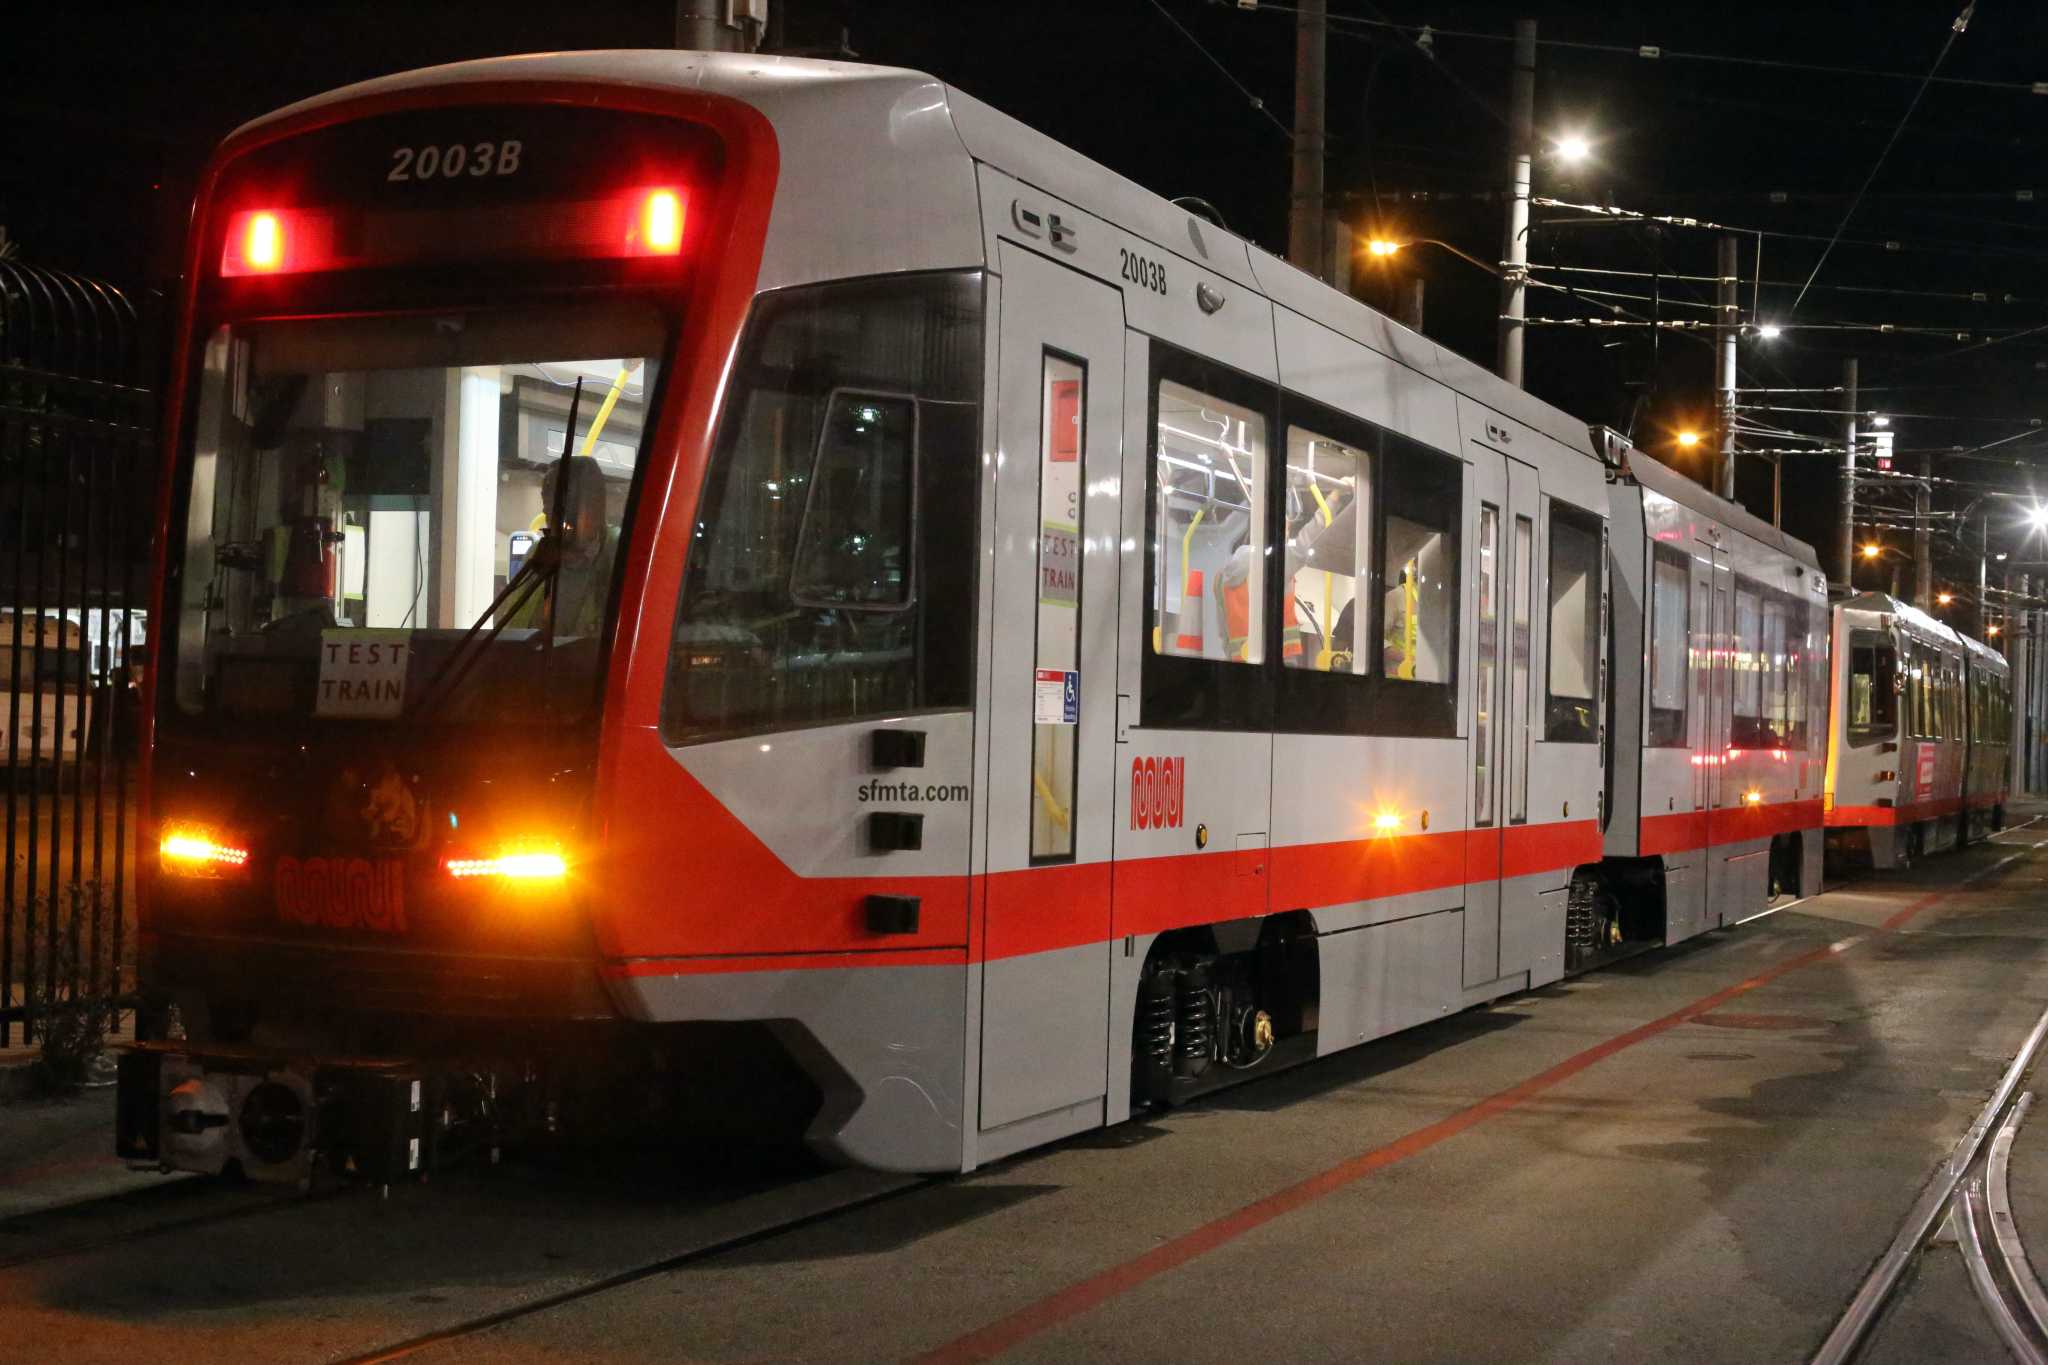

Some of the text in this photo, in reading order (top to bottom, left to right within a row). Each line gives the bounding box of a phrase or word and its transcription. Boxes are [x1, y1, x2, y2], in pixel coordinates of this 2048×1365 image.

[387, 140, 523, 182] 2003B
[1120, 247, 1167, 296] 2003B
[1042, 567, 1076, 591] TRAIN
[326, 643, 405, 665] TEST
[320, 679, 401, 701] TRAIN
[858, 778, 969, 803] sfmta.com
